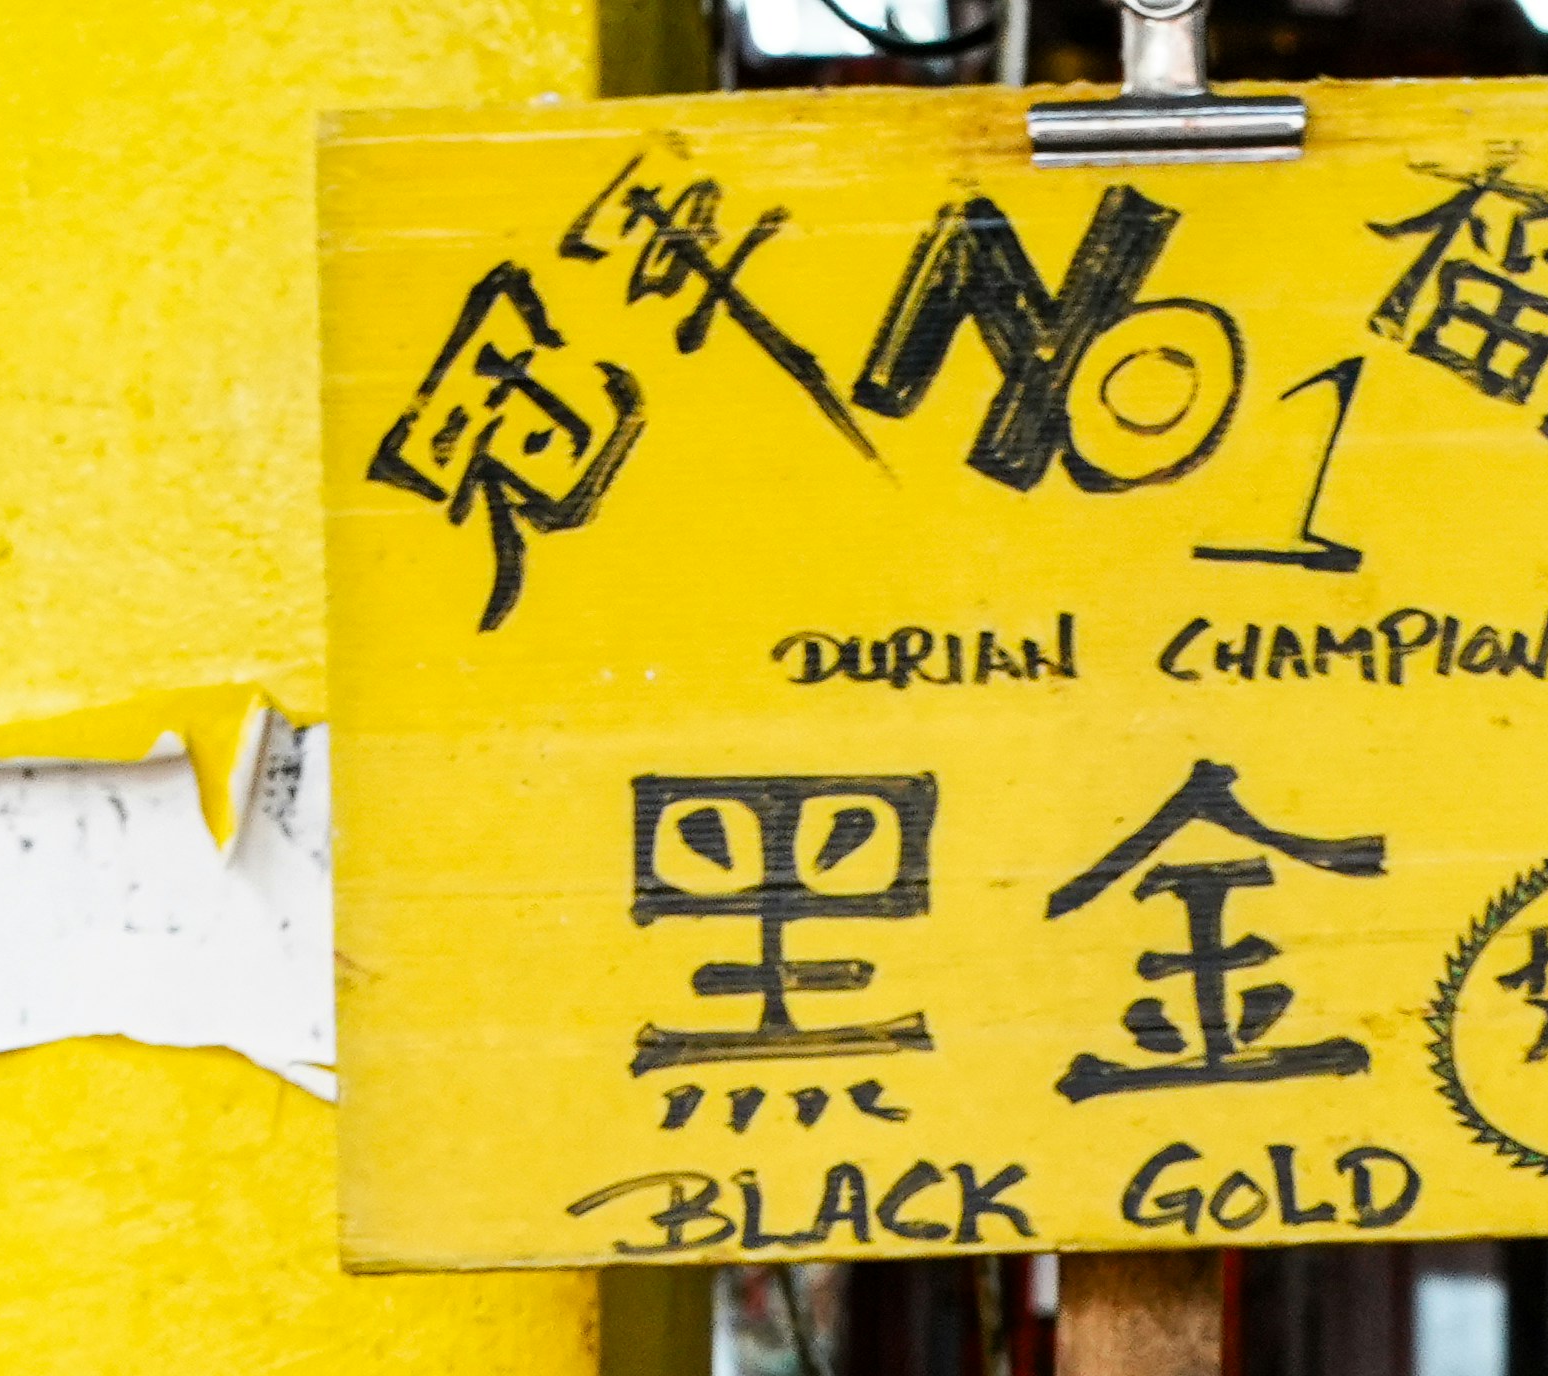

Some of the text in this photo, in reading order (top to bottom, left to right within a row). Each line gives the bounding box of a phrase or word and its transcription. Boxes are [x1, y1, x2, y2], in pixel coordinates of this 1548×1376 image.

[771, 612, 1078, 688] DURIAN
[629, 758, 1388, 1132] 黑金
[566, 1142, 1422, 1254] BLACK GOLD
